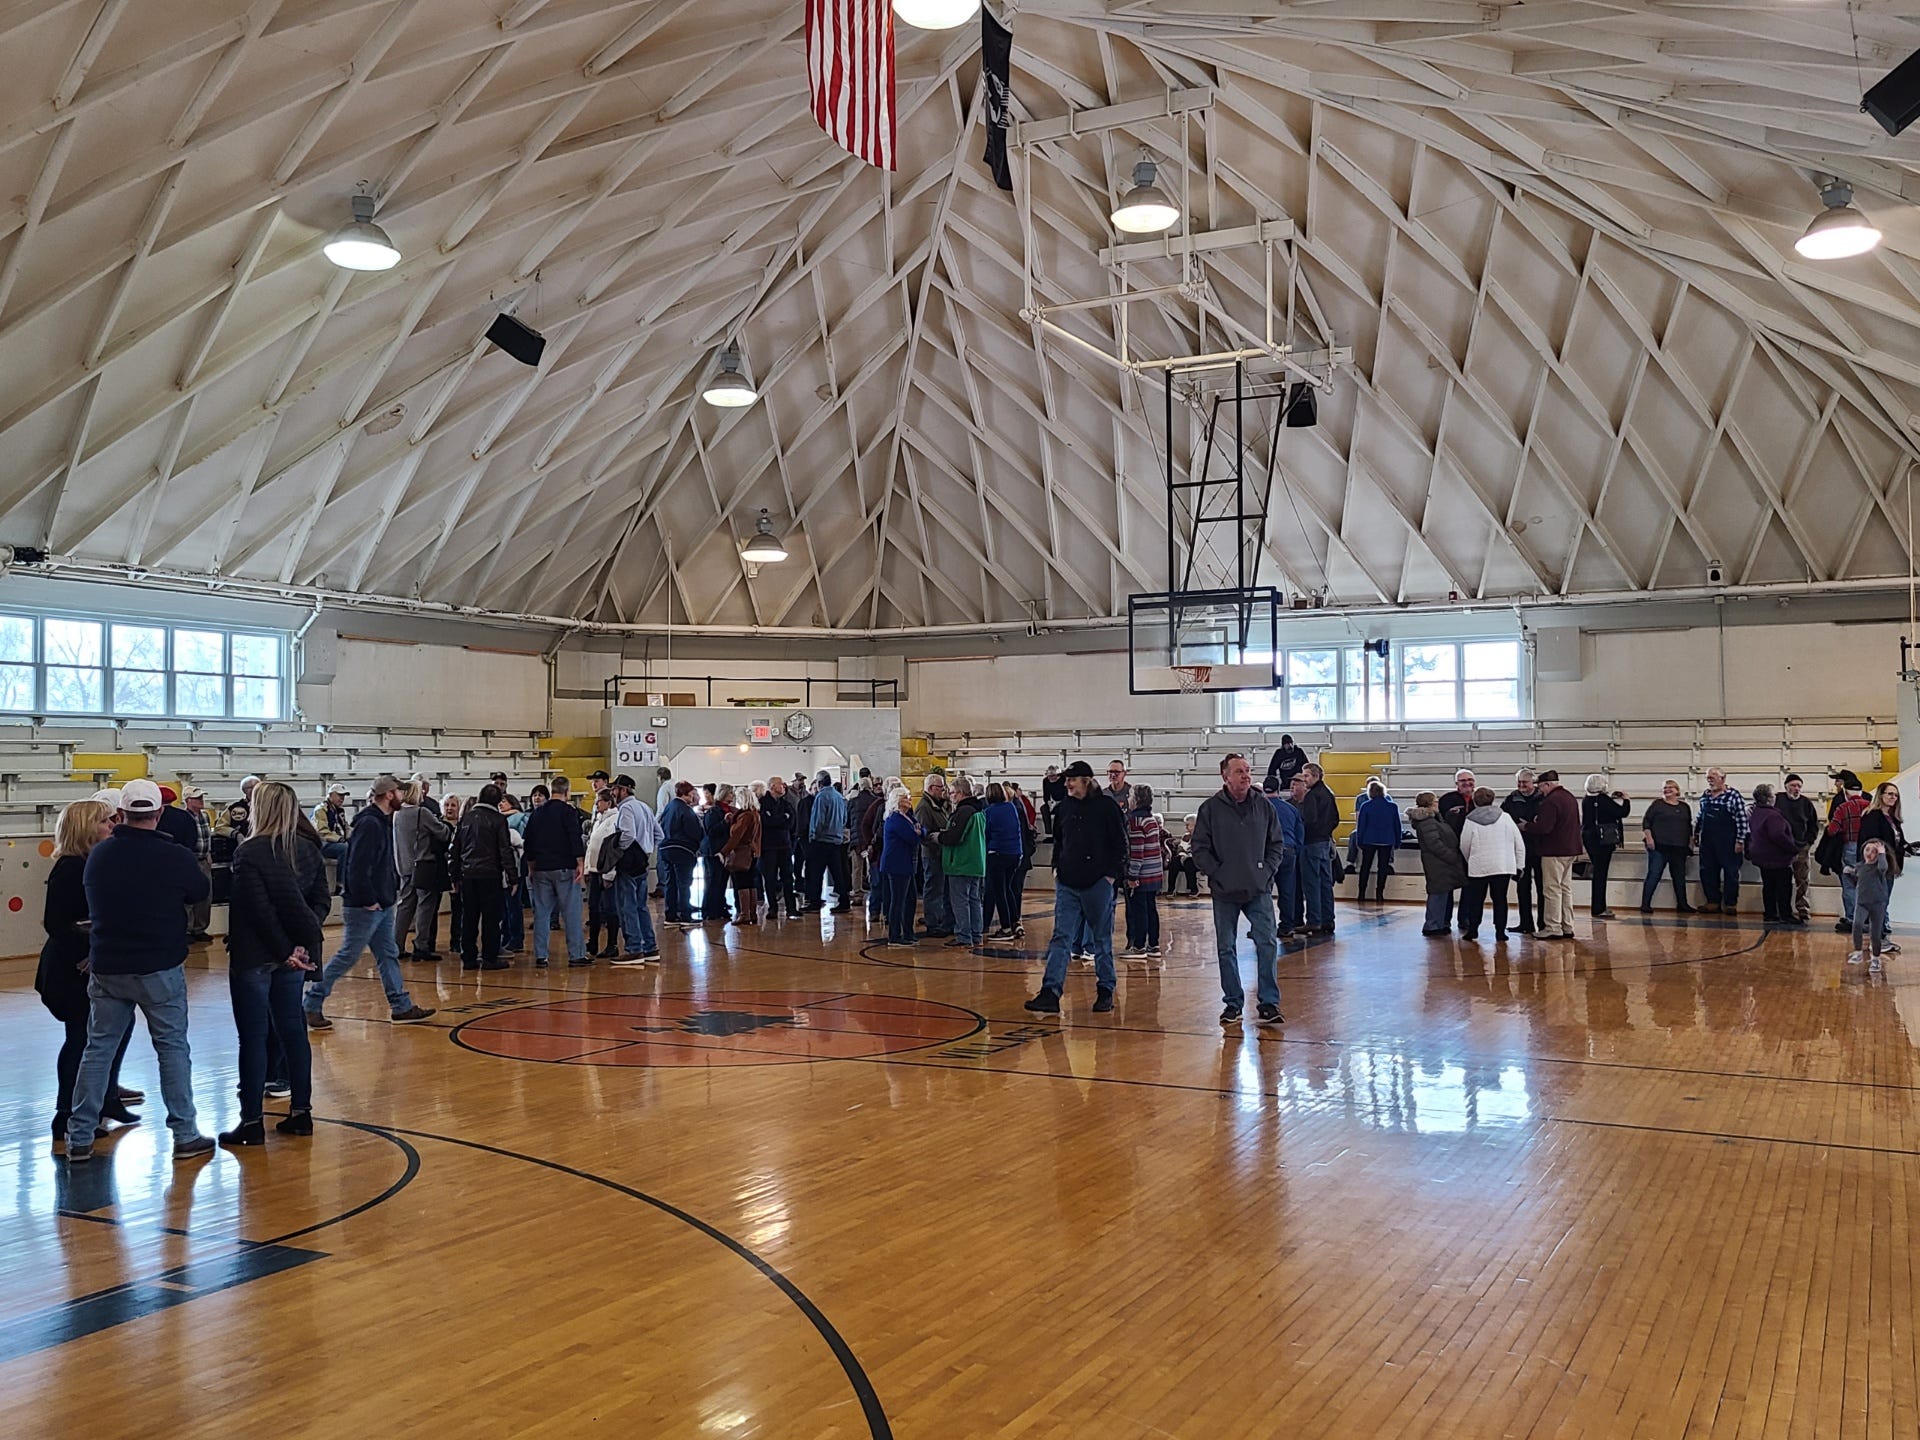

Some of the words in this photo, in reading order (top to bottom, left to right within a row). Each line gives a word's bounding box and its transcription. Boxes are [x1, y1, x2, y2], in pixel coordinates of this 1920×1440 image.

[618, 732, 656, 745] DUG
[619, 750, 656, 762] OUT
[926, 1026, 1067, 1059] VILLAGE
